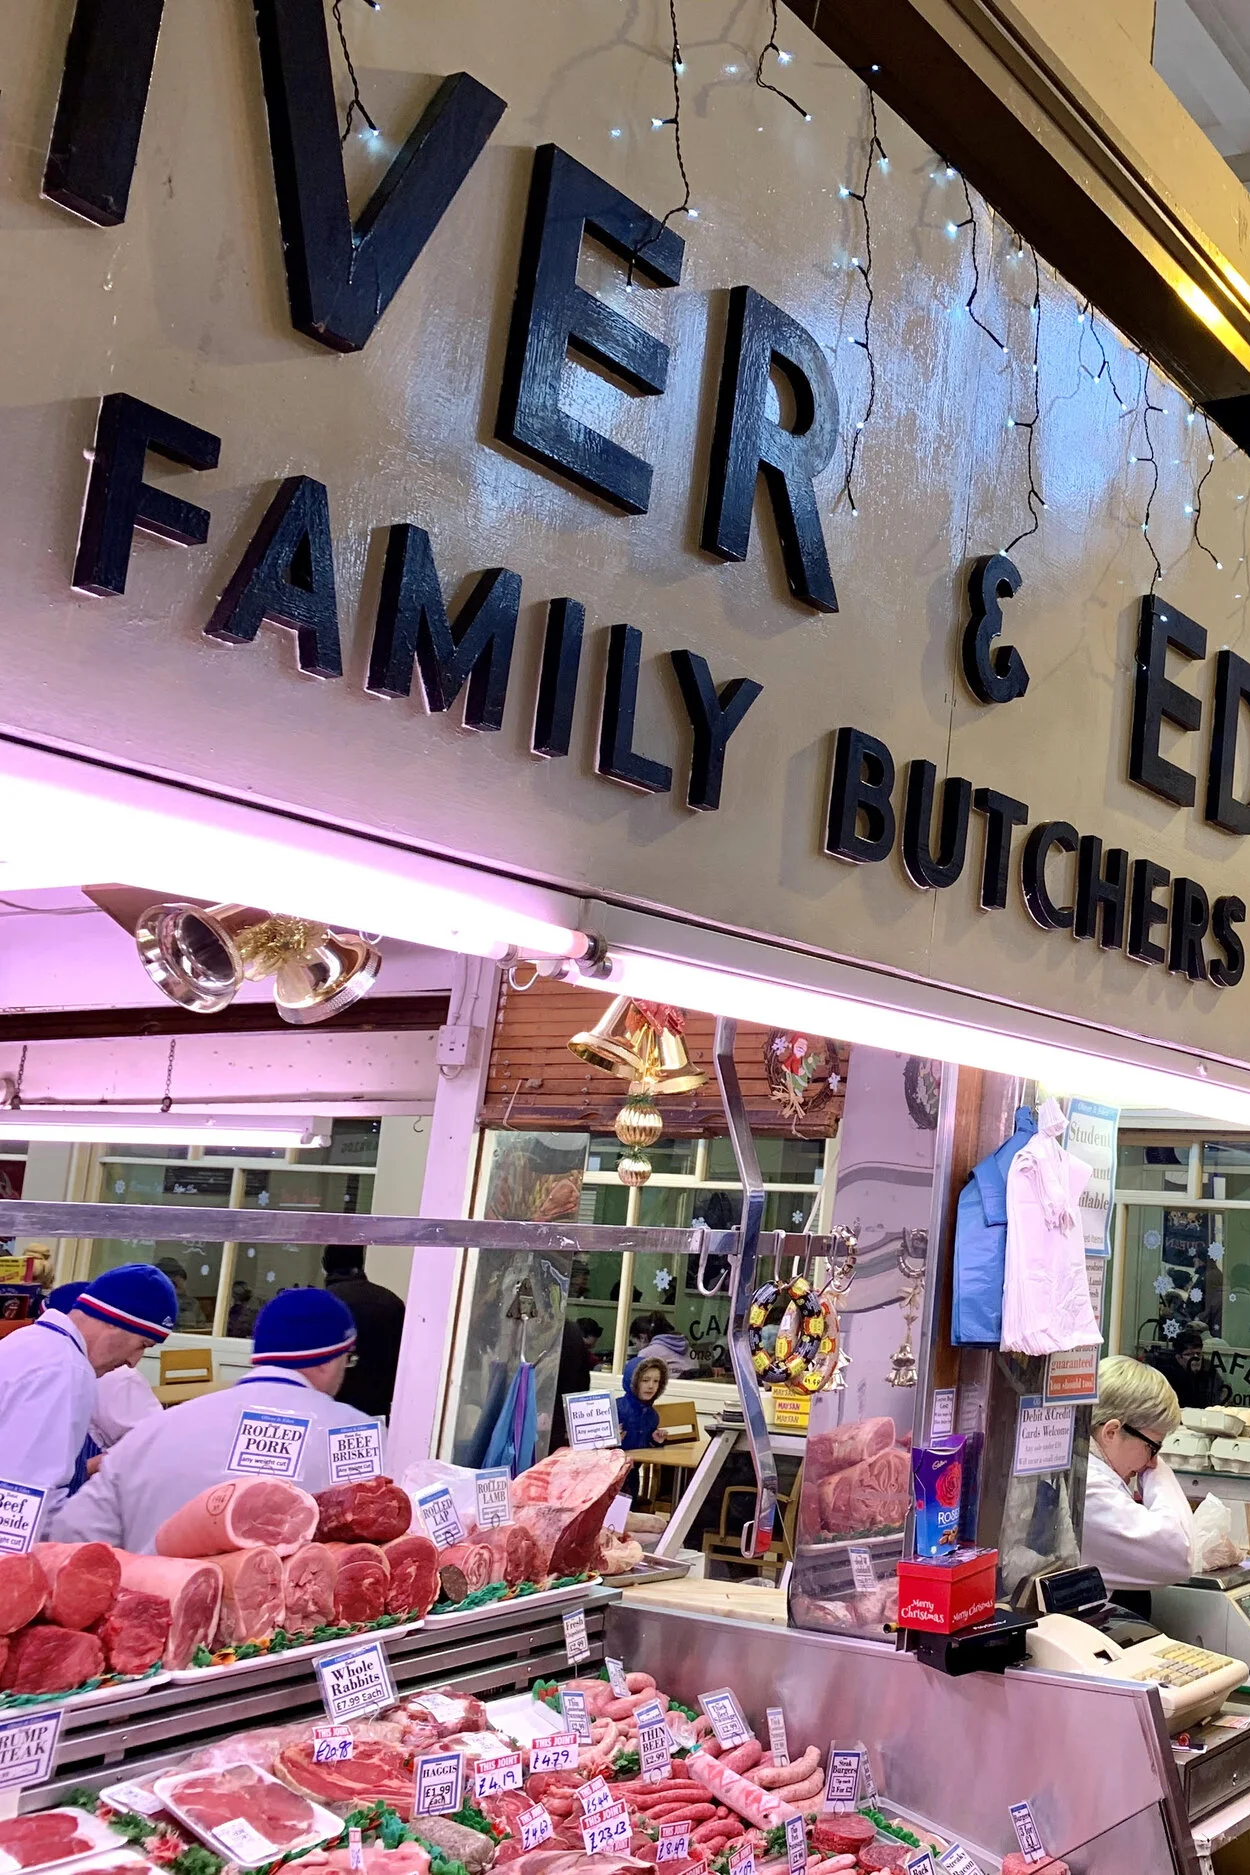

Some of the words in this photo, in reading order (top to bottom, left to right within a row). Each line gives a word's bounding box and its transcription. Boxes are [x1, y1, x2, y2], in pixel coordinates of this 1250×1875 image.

[961, 553, 1030, 704] &
[70, 392, 765, 813] FAMILY
[823, 726, 1247, 989] BUTCHERS
[1069, 1121, 1111, 1149] Student
[689, 1314, 729, 1341] CA
[1051, 1354, 1094, 1374] guaranteed
[572, 1410, 586, 1420] Rib
[586, 1409, 594, 1418] of
[596, 1407, 612, 1417] Beef
[778, 1402, 800, 1410] MAYSAN
[1022, 1408, 1043, 1423] Debit
[241, 1424, 302, 1442] ROLLED
[1022, 1426, 1041, 1439] Cards
[1042, 1426, 1070, 1437] Welcome
[245, 1438, 292, 1455] PORK
[338, 1436, 372, 1452] BEEF
[254, 1456, 276, 1466] weight
[276, 1459, 286, 1467] cut
[332, 1446, 379, 1463] BRISKET
[478, 1480, 507, 1494] ROLLED
[482, 1491, 506, 1504] LAMB
[422, 1498, 452, 1520] ROLLED
[432, 1510, 450, 1526] LAP
[911, 1599, 934, 1612] Merry
[952, 1608, 968, 1623] Merry
[968, 1600, 994, 1616] Christmas
[901, 1606, 945, 1624] Christmas
[566, 1618, 584, 1630] Fresh
[331, 1660, 374, 1682] Whole
[330, 1672, 380, 1698] Rabbits
[336, 1696, 360, 1712] £7.99
[362, 1689, 382, 1702] Each
[317, 1728, 332, 1738] THIS
[640, 1728, 664, 1742] THIN
[535, 1738, 552, 1748] THIS
[553, 1735, 575, 1746] JOINT
[642, 1737, 666, 1753] BEEF
[479, 1762, 496, 1772] THIS
[497, 1755, 518, 1768] JOINT
[644, 1752, 664, 1764] £2.99
[838, 1759, 852, 1767] Steak
[422, 1764, 458, 1778] HAGGIS
[832, 1766, 857, 1775] Burgers
[425, 1784, 451, 1798] £1.99
[584, 1815, 600, 1828] THIS
[602, 1804, 623, 1821] JOINT
[662, 1826, 674, 1837] THIS
[674, 1824, 689, 1836] JOINT
[946, 1852, 966, 1870] Streaky
[953, 1860, 974, 1875] Bacon
[913, 1864, 929, 1875] Back
